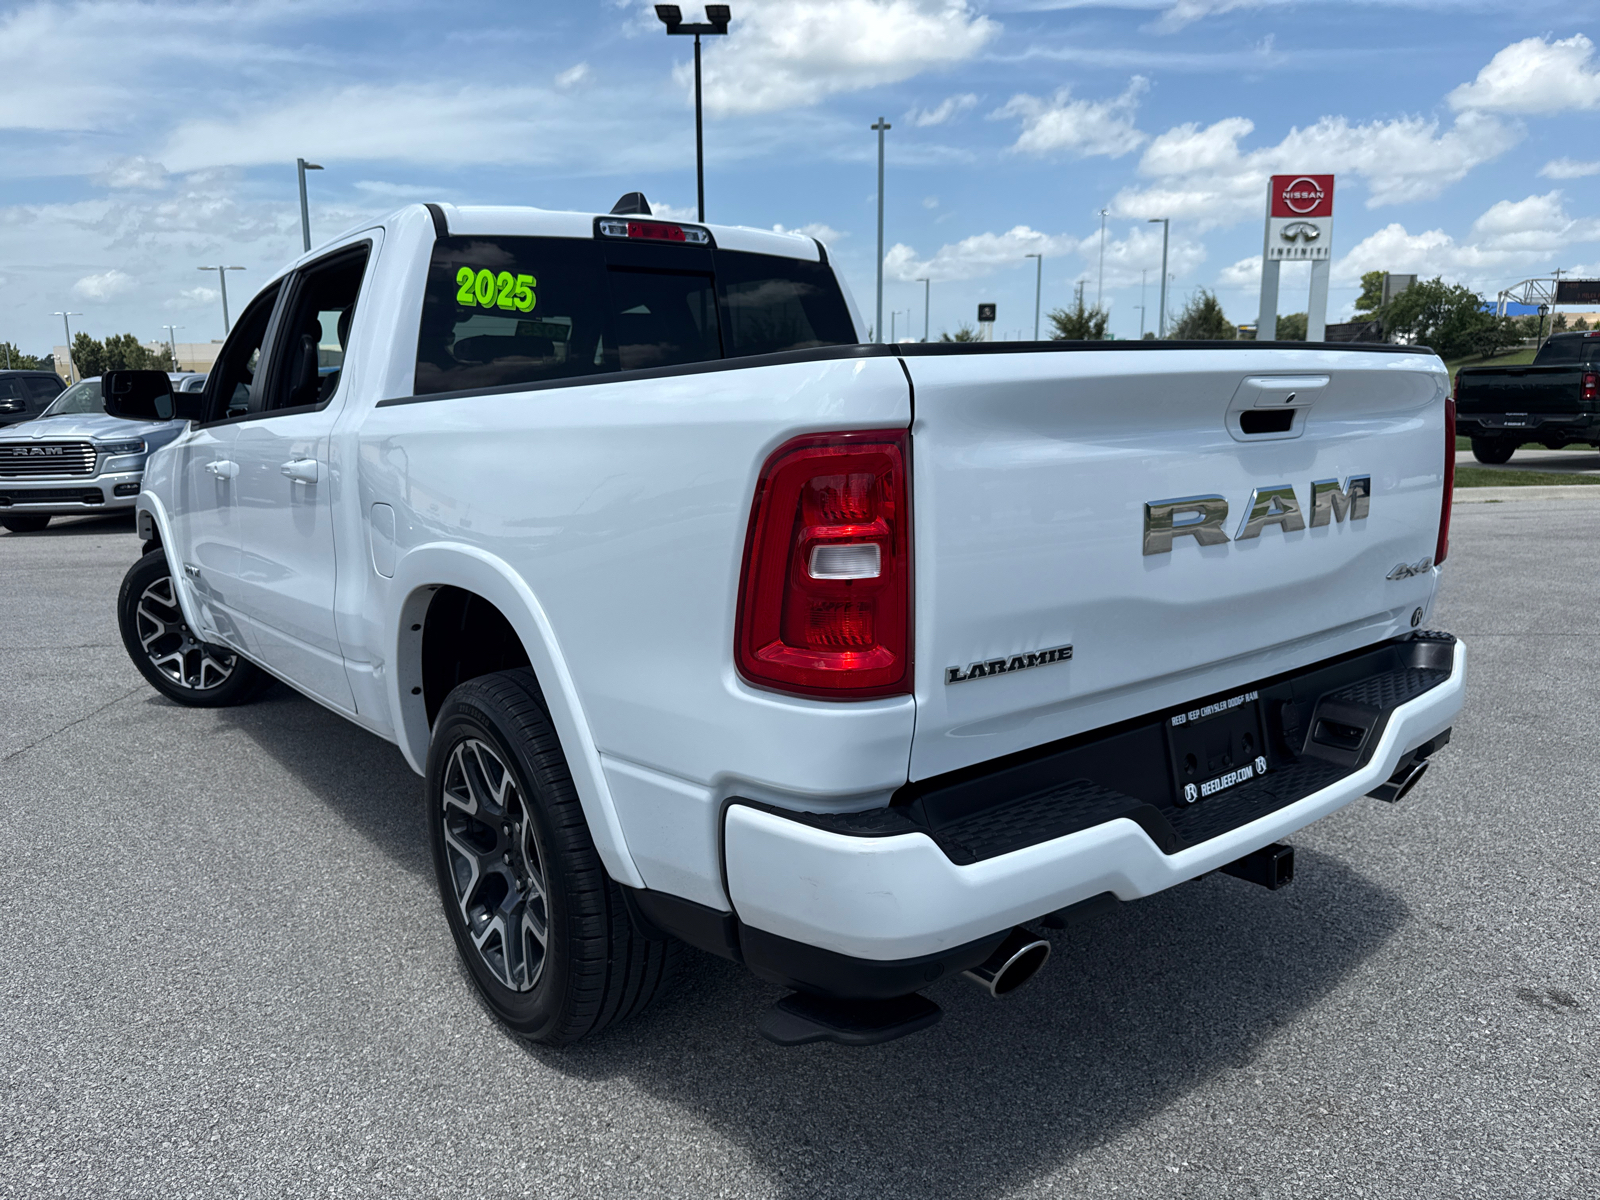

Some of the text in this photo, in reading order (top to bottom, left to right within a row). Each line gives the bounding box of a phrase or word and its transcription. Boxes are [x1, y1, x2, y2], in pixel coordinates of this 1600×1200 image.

[1282, 191, 1325, 199] NISSAN
[1270, 247, 1328, 256] INFINITI
[456, 266, 537, 313] 2025
[12, 447, 63, 456] RAM
[1142, 474, 1371, 556] RAM
[1386, 556, 1433, 580] 4x4
[944, 643, 1074, 685] LARAMIE
[1171, 713, 1187, 727] REED
[1187, 709, 1200, 721] JEEP
[1200, 700, 1227, 717] CHRYSLER
[1245, 690, 1259, 703] RAM
[1200, 765, 1254, 797] REEDJEEP.COM
